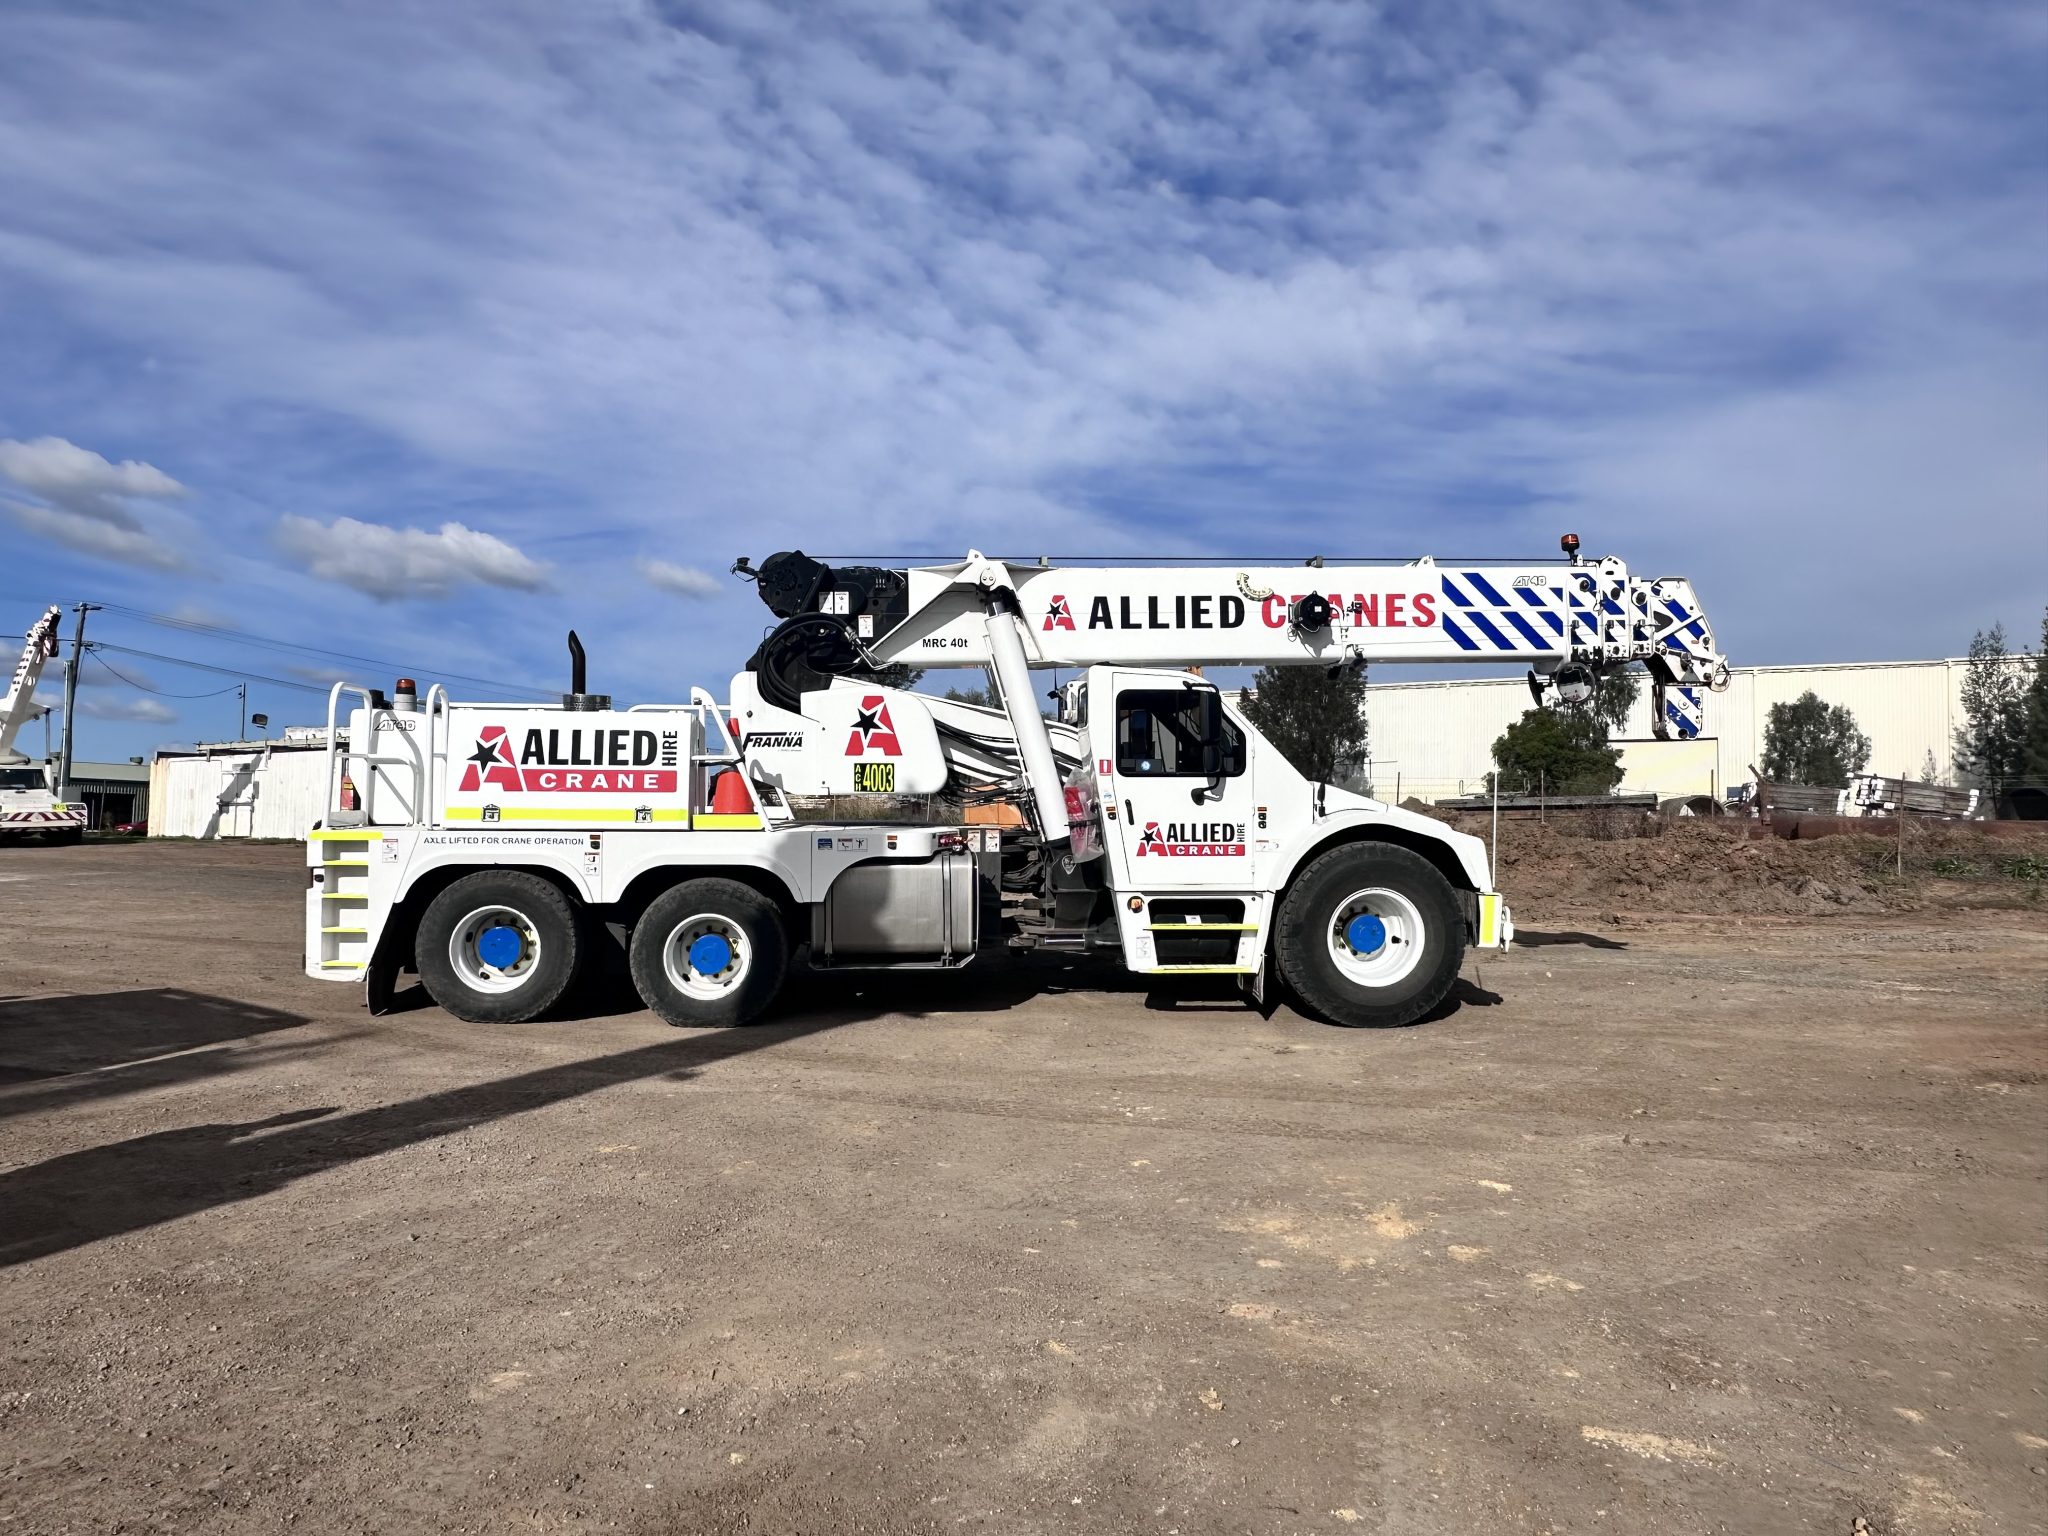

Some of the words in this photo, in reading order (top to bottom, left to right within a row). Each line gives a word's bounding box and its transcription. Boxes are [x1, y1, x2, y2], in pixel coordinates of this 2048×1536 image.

[1088, 595, 1246, 629] ALLIED
[922, 638, 947, 648] MRC
[950, 638, 968, 648] 40t
[520, 729, 658, 766] ALLIED
[662, 730, 678, 767] HIRE
[743, 732, 803, 752] FRANNA
[539, 772, 659, 789] CRANE
[863, 764, 893, 792] 4003
[501, 837, 532, 845] CRANE
[1166, 823, 1235, 843] ALLIED
[1236, 822, 1246, 843] HIRE
[1175, 845, 1237, 855] CRANE
